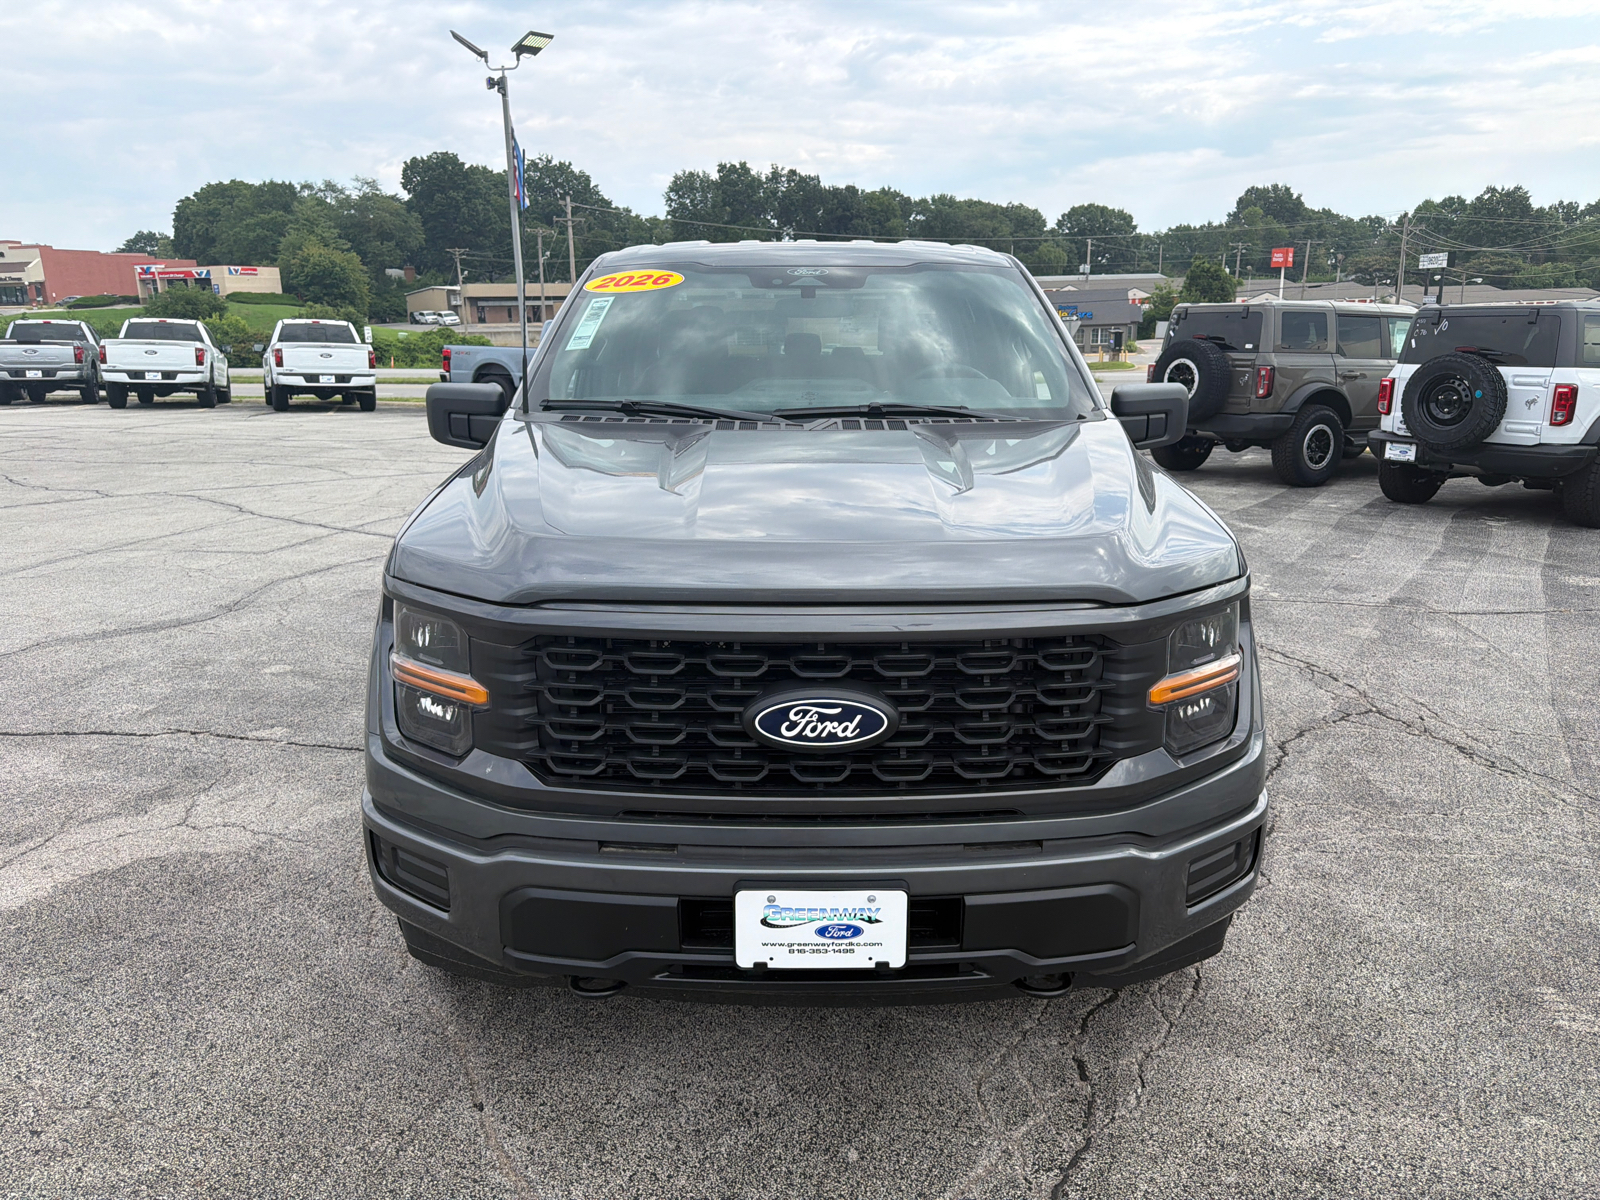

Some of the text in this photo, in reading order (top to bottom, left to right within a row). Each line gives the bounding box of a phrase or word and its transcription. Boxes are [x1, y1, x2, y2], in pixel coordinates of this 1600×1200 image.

[592, 274, 674, 289] 2026
[781, 705, 862, 737] Ford
[763, 904, 881, 921] GREENWAY
[825, 925, 854, 938] Ford
